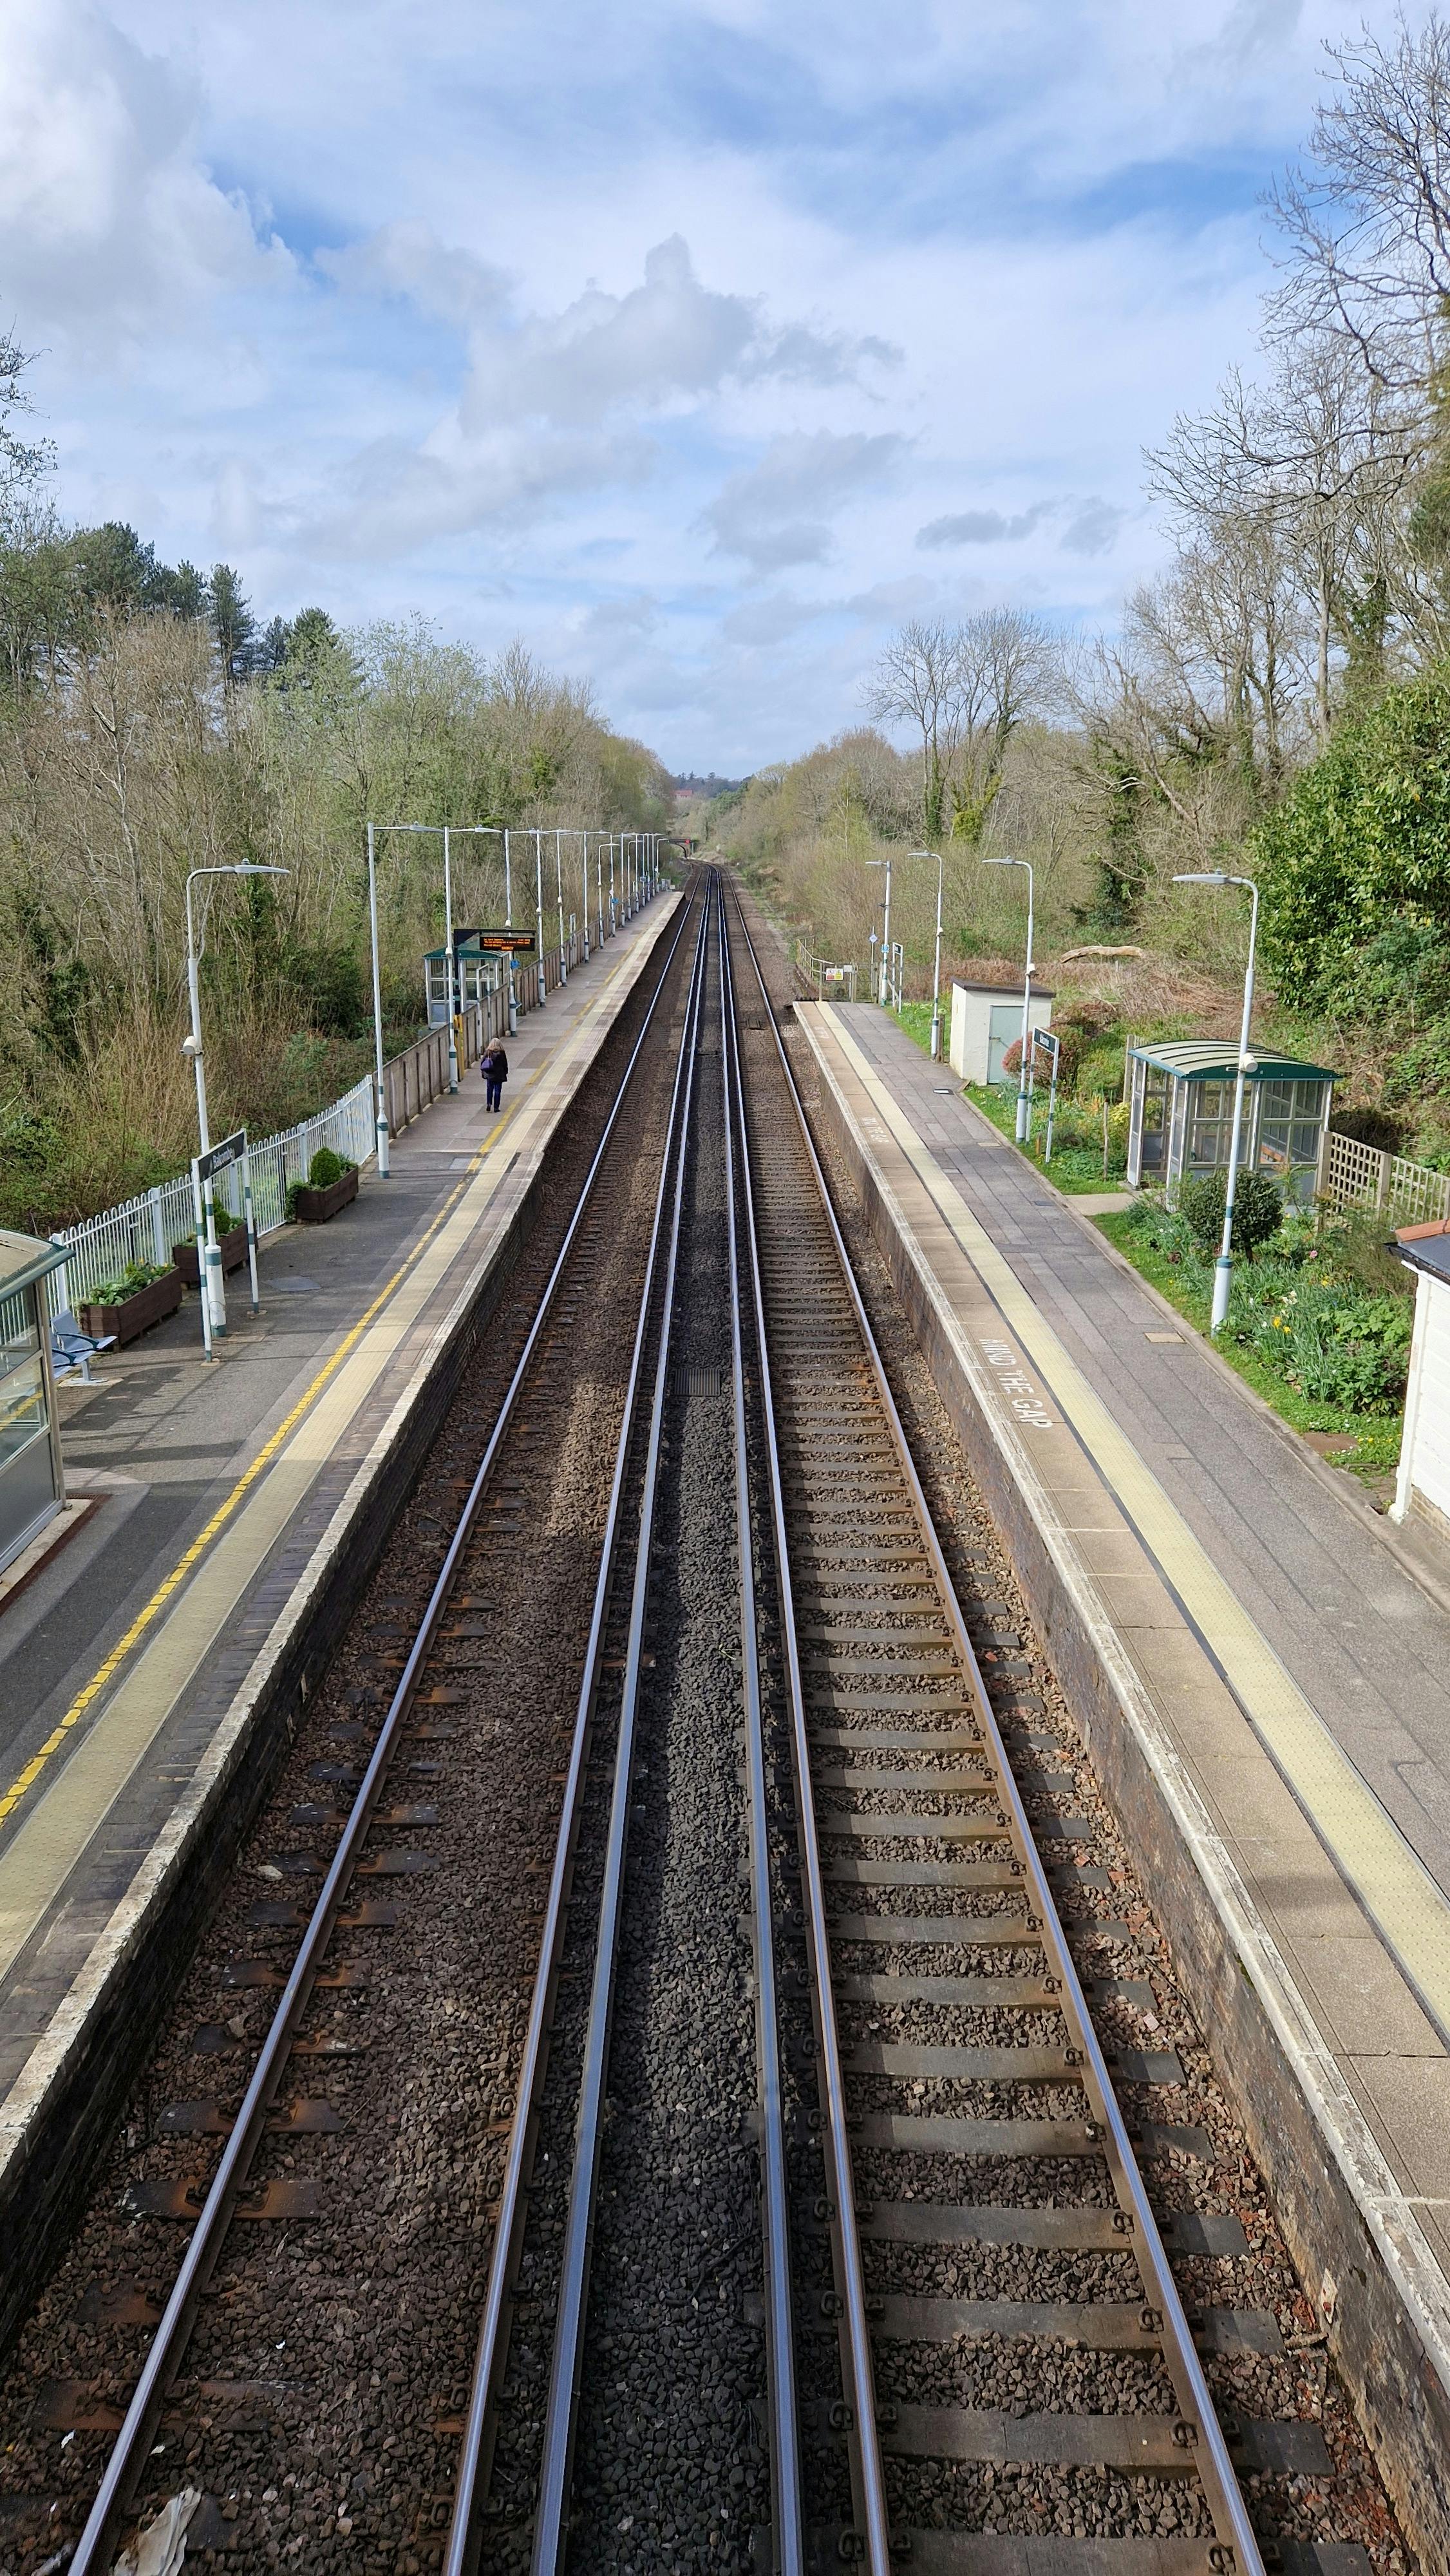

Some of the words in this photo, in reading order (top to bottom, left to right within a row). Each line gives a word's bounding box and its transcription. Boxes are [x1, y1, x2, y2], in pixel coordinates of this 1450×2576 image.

[979, 1339, 1016, 1366] MIND
[997, 1370, 1035, 1394] THE
[1012, 1398, 1053, 1428] GAP
